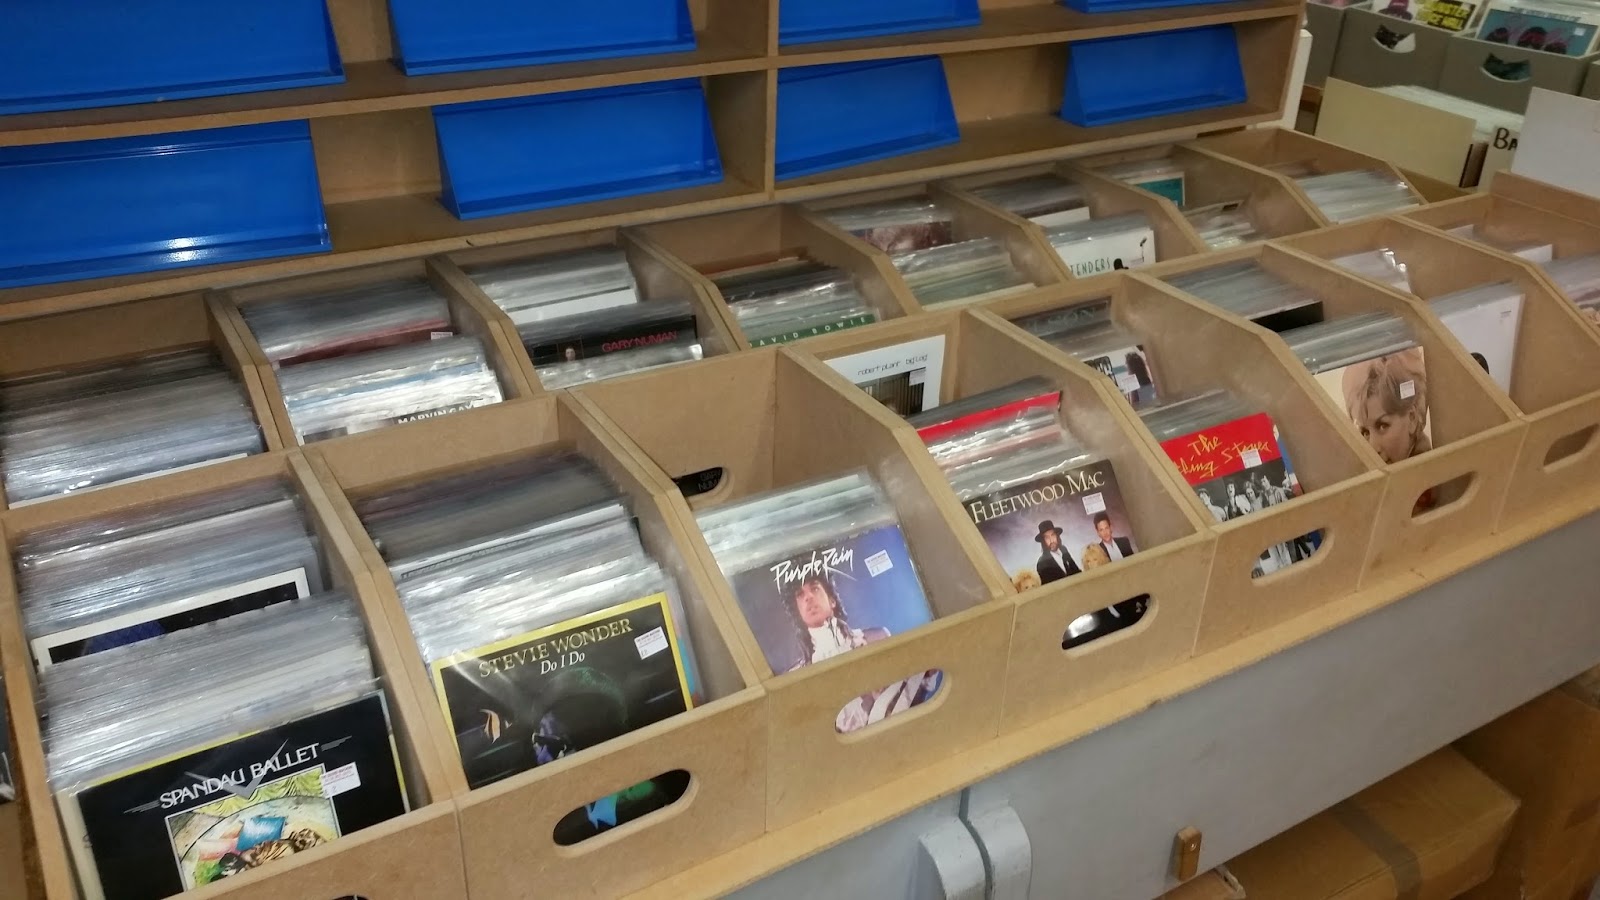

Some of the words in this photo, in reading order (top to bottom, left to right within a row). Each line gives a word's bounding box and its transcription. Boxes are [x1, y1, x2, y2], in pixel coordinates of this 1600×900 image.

[1070, 257, 1110, 276] TENDERS
[812, 317, 865, 335] BOWIE
[601, 337, 635, 352] GARY
[635, 331, 677, 347] NUMAN
[858, 365, 880, 376] robert
[1188, 434, 1223, 456] The
[970, 483, 1065, 524] FLEETWOOD
[1065, 471, 1105, 495] MAC
[770, 551, 822, 594] Purple
[821, 547, 857, 581] Rain
[478, 643, 550, 678] STEVIE
[550, 618, 633, 654] WONDER
[540, 660, 557, 675] Do
[560, 655, 566, 668] I
[568, 651, 586, 666] Do
[159, 768, 246, 809] SPANDAU
[250, 742, 319, 778] BALLET
